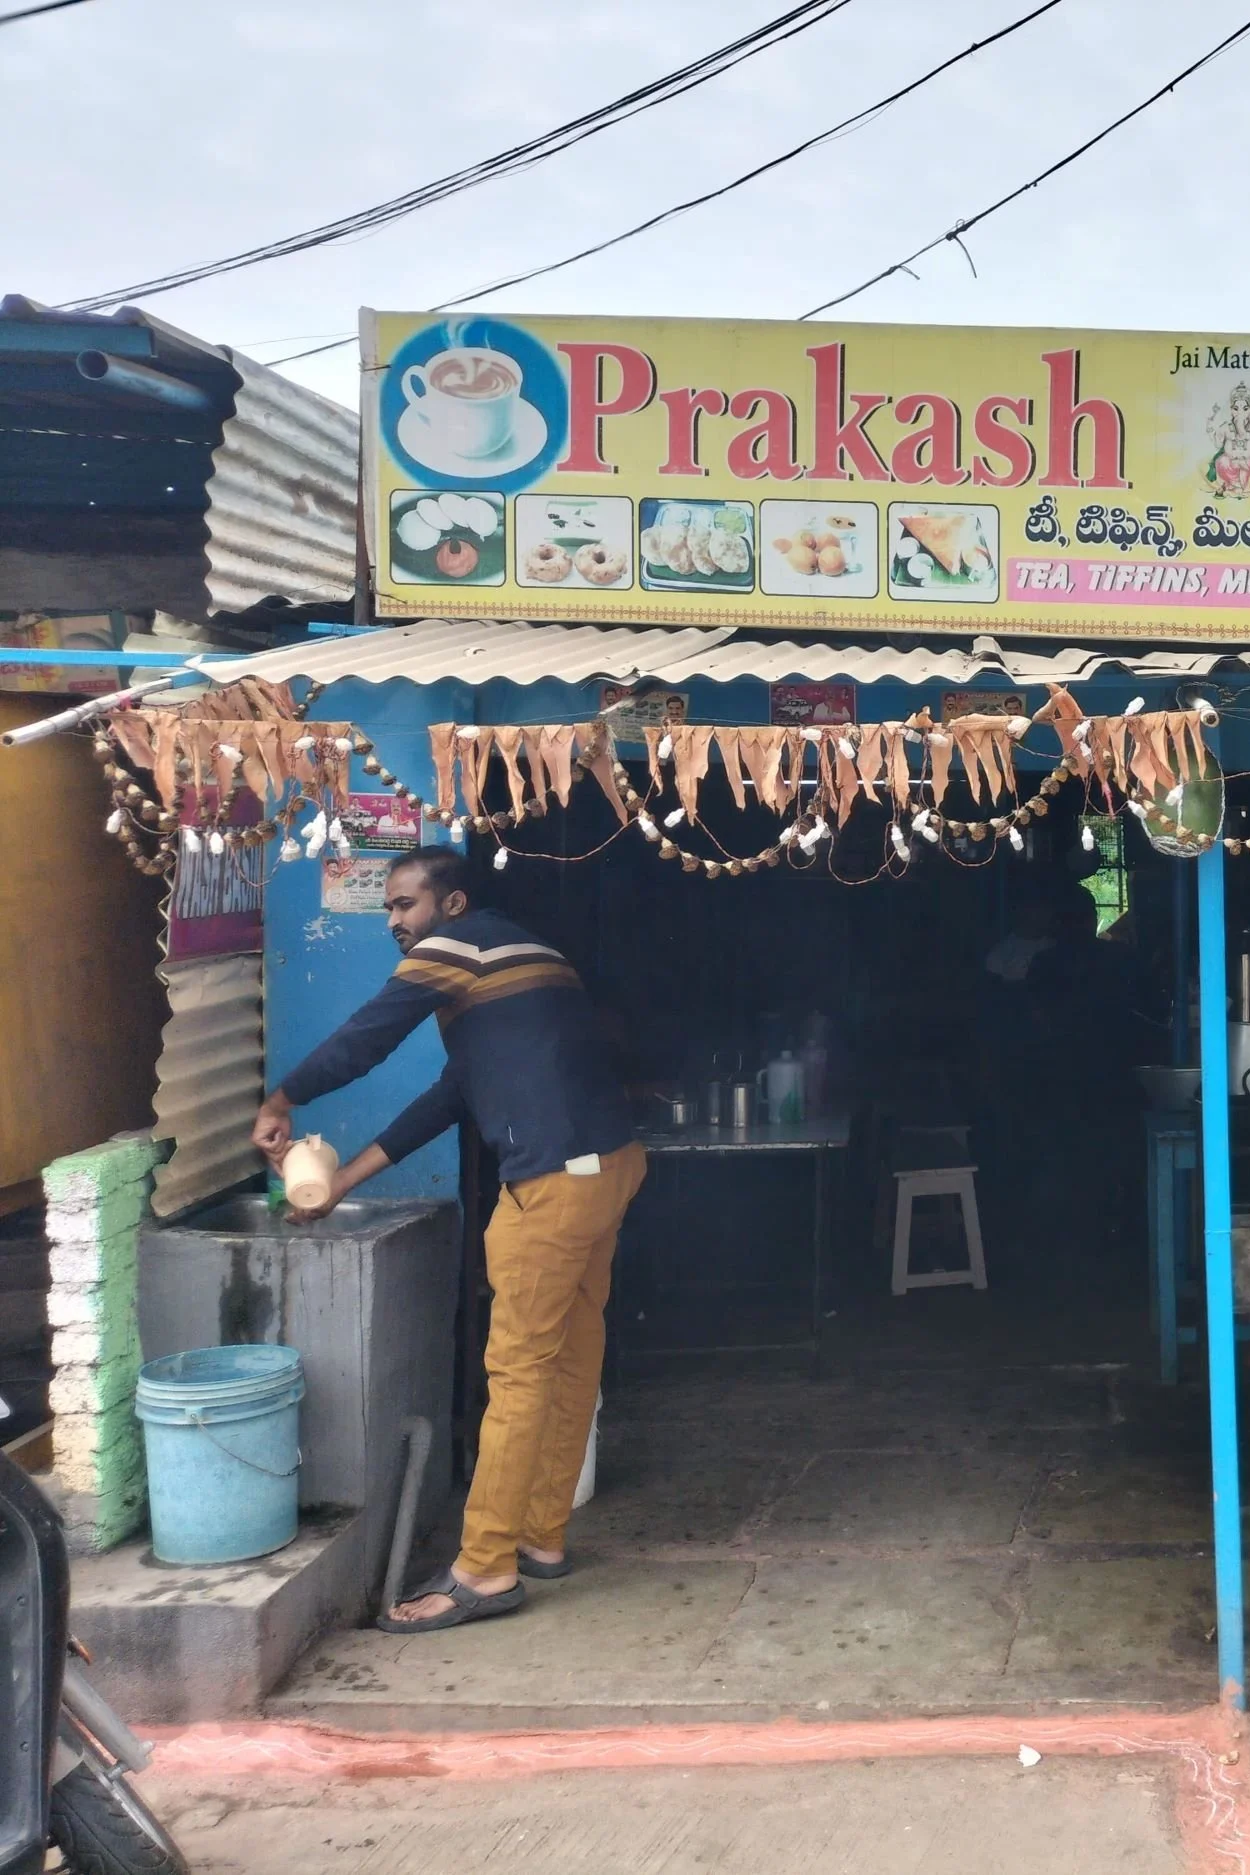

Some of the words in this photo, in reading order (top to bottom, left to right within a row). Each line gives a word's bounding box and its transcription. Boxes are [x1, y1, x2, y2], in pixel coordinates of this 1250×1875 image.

[1170, 345, 1199, 374] Jai
[555, 342, 1133, 490] Prakash
[1016, 561, 1076, 594] TEA,
[1087, 564, 1210, 598] TIFFINS,
